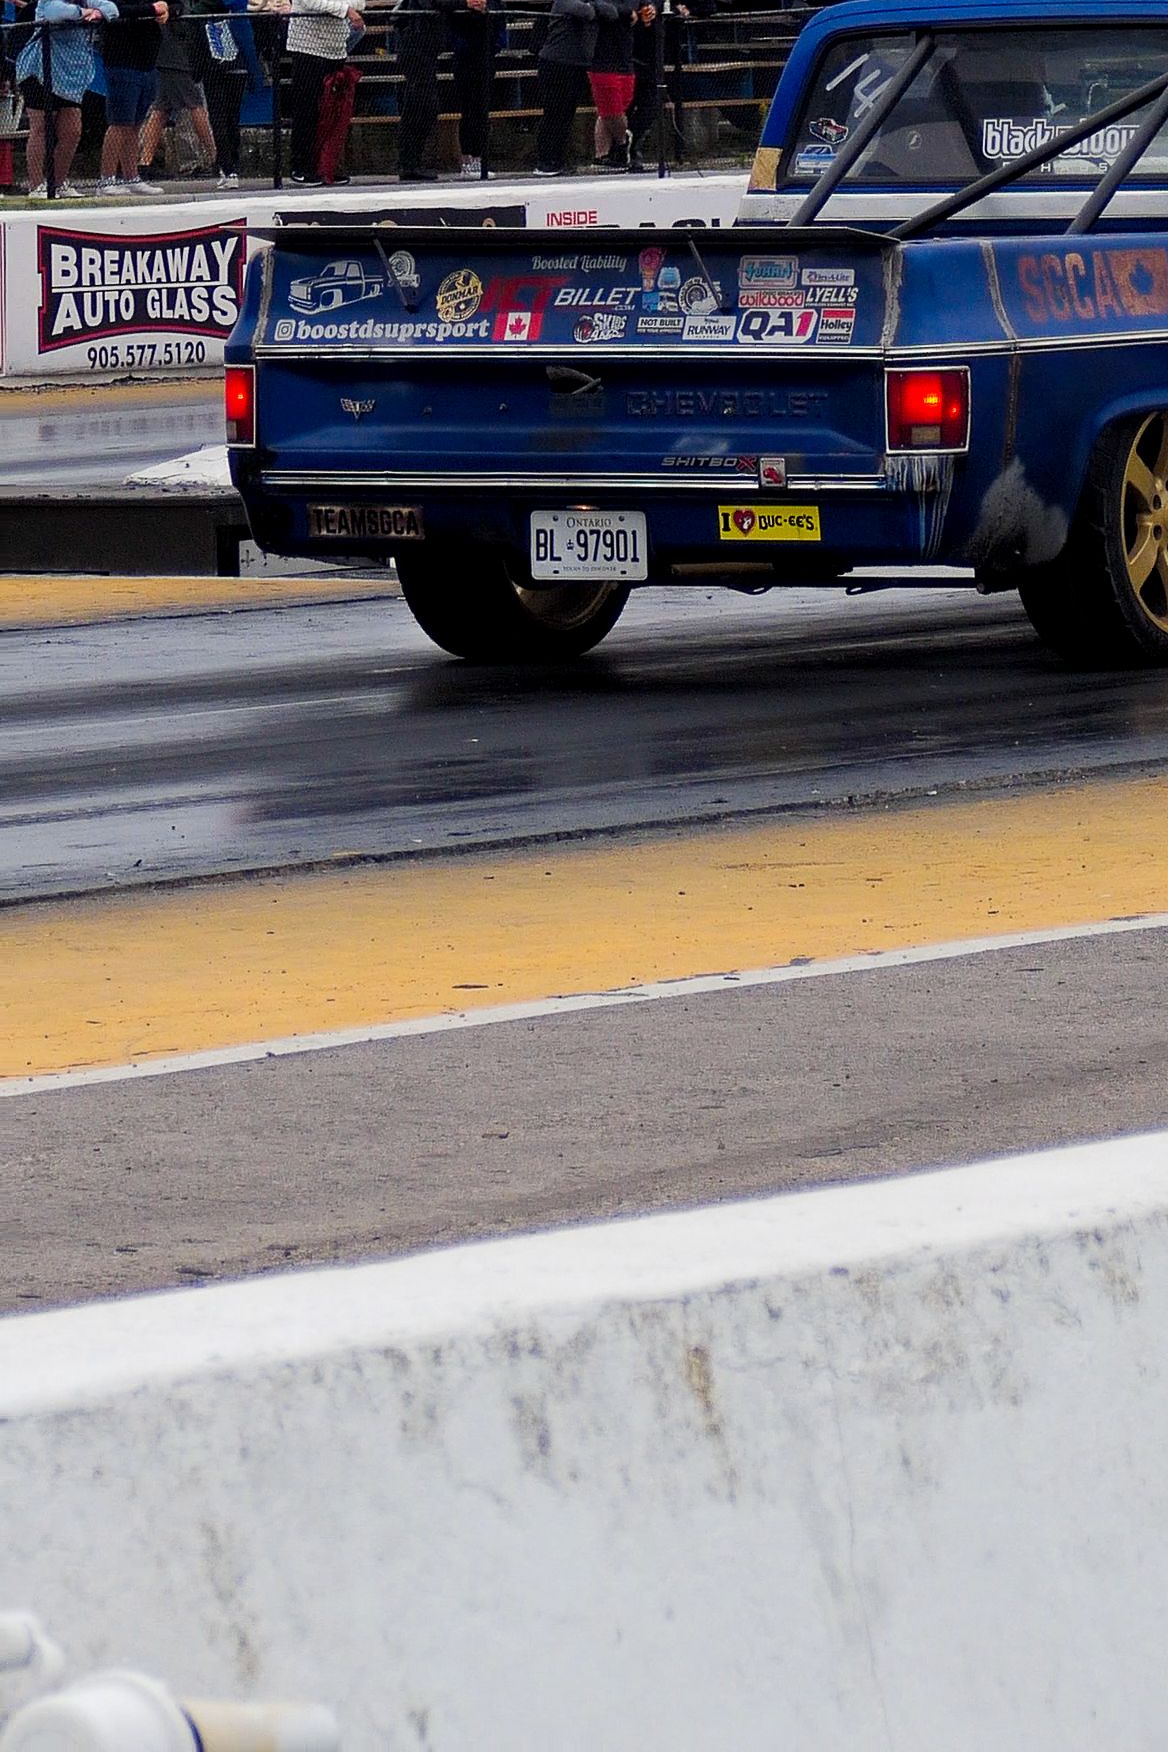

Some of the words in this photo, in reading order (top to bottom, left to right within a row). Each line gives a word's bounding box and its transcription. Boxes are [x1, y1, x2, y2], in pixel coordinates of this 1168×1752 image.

[983, 119, 1052, 159] black
[1055, 118, 1140, 159] ido
[547, 211, 597, 227] INSIDE
[51, 237, 238, 288] BREAKAWAY
[532, 256, 578, 270] Boosted
[580, 255, 627, 272] Liability
[554, 287, 642, 306] BILLET
[806, 287, 859, 302] LYELL'S
[1018, 252, 1122, 324] SGCA
[52, 290, 135, 336] AUTO
[146, 285, 238, 326] GLASS
[296, 319, 490, 342] boostdsuprsport
[640, 319, 657, 327] NOT
[660, 319, 681, 327] BUILT
[687, 326, 731, 336] RUNWAY
[741, 311, 814, 340] QA1
[820, 319, 852, 333] Holley
[88, 341, 205, 369] 905.577.5120
[661, 455, 758, 471] SHITBOX
[313, 508, 419, 535] TEAMSGCA
[721, 512, 731, 531] I
[759, 513, 815, 531] BUC-EE'S
[536, 529, 562, 562] BL
[576, 529, 640, 563] 97901
